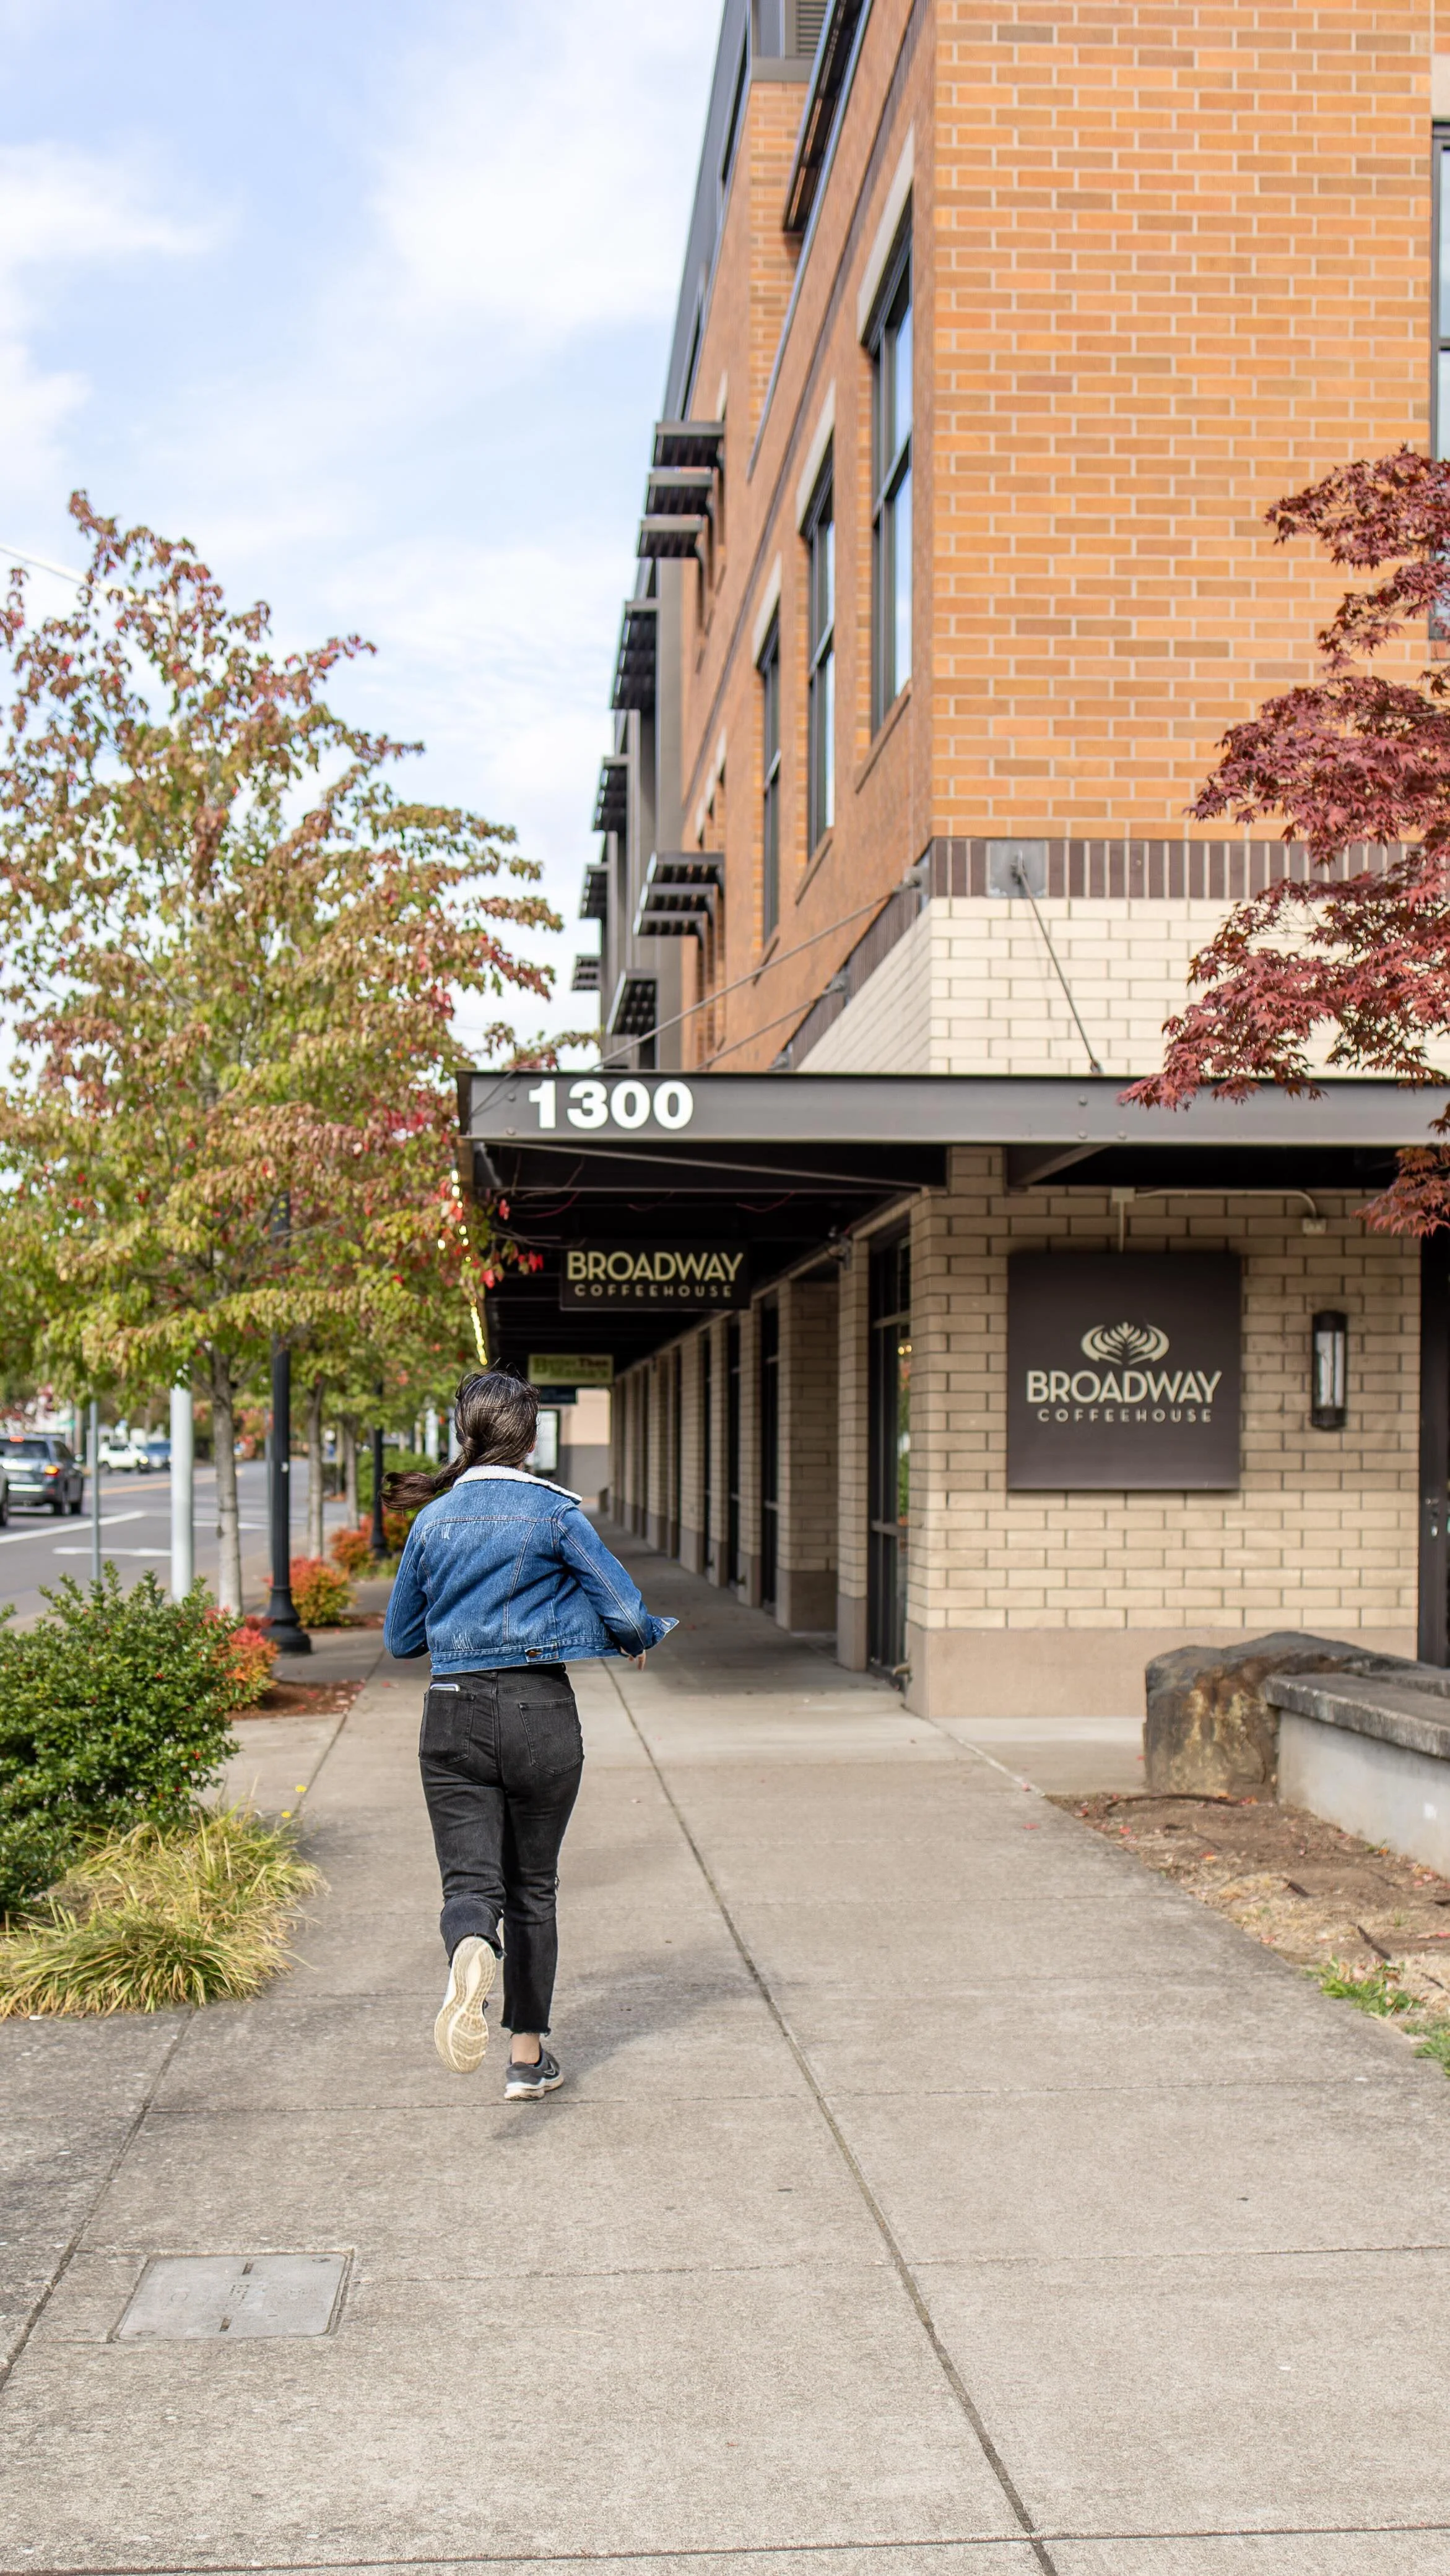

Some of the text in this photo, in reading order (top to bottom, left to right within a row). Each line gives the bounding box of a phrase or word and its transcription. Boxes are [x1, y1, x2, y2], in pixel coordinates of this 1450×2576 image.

[528, 1079, 694, 1130] 1300
[568, 1251, 743, 1281] BROADWAY
[574, 1284, 732, 1297] COFFEEHOUSE
[1027, 1370, 1222, 1403] BROADWAY
[1037, 1408, 1212, 1423] COFFEEHOUSE
